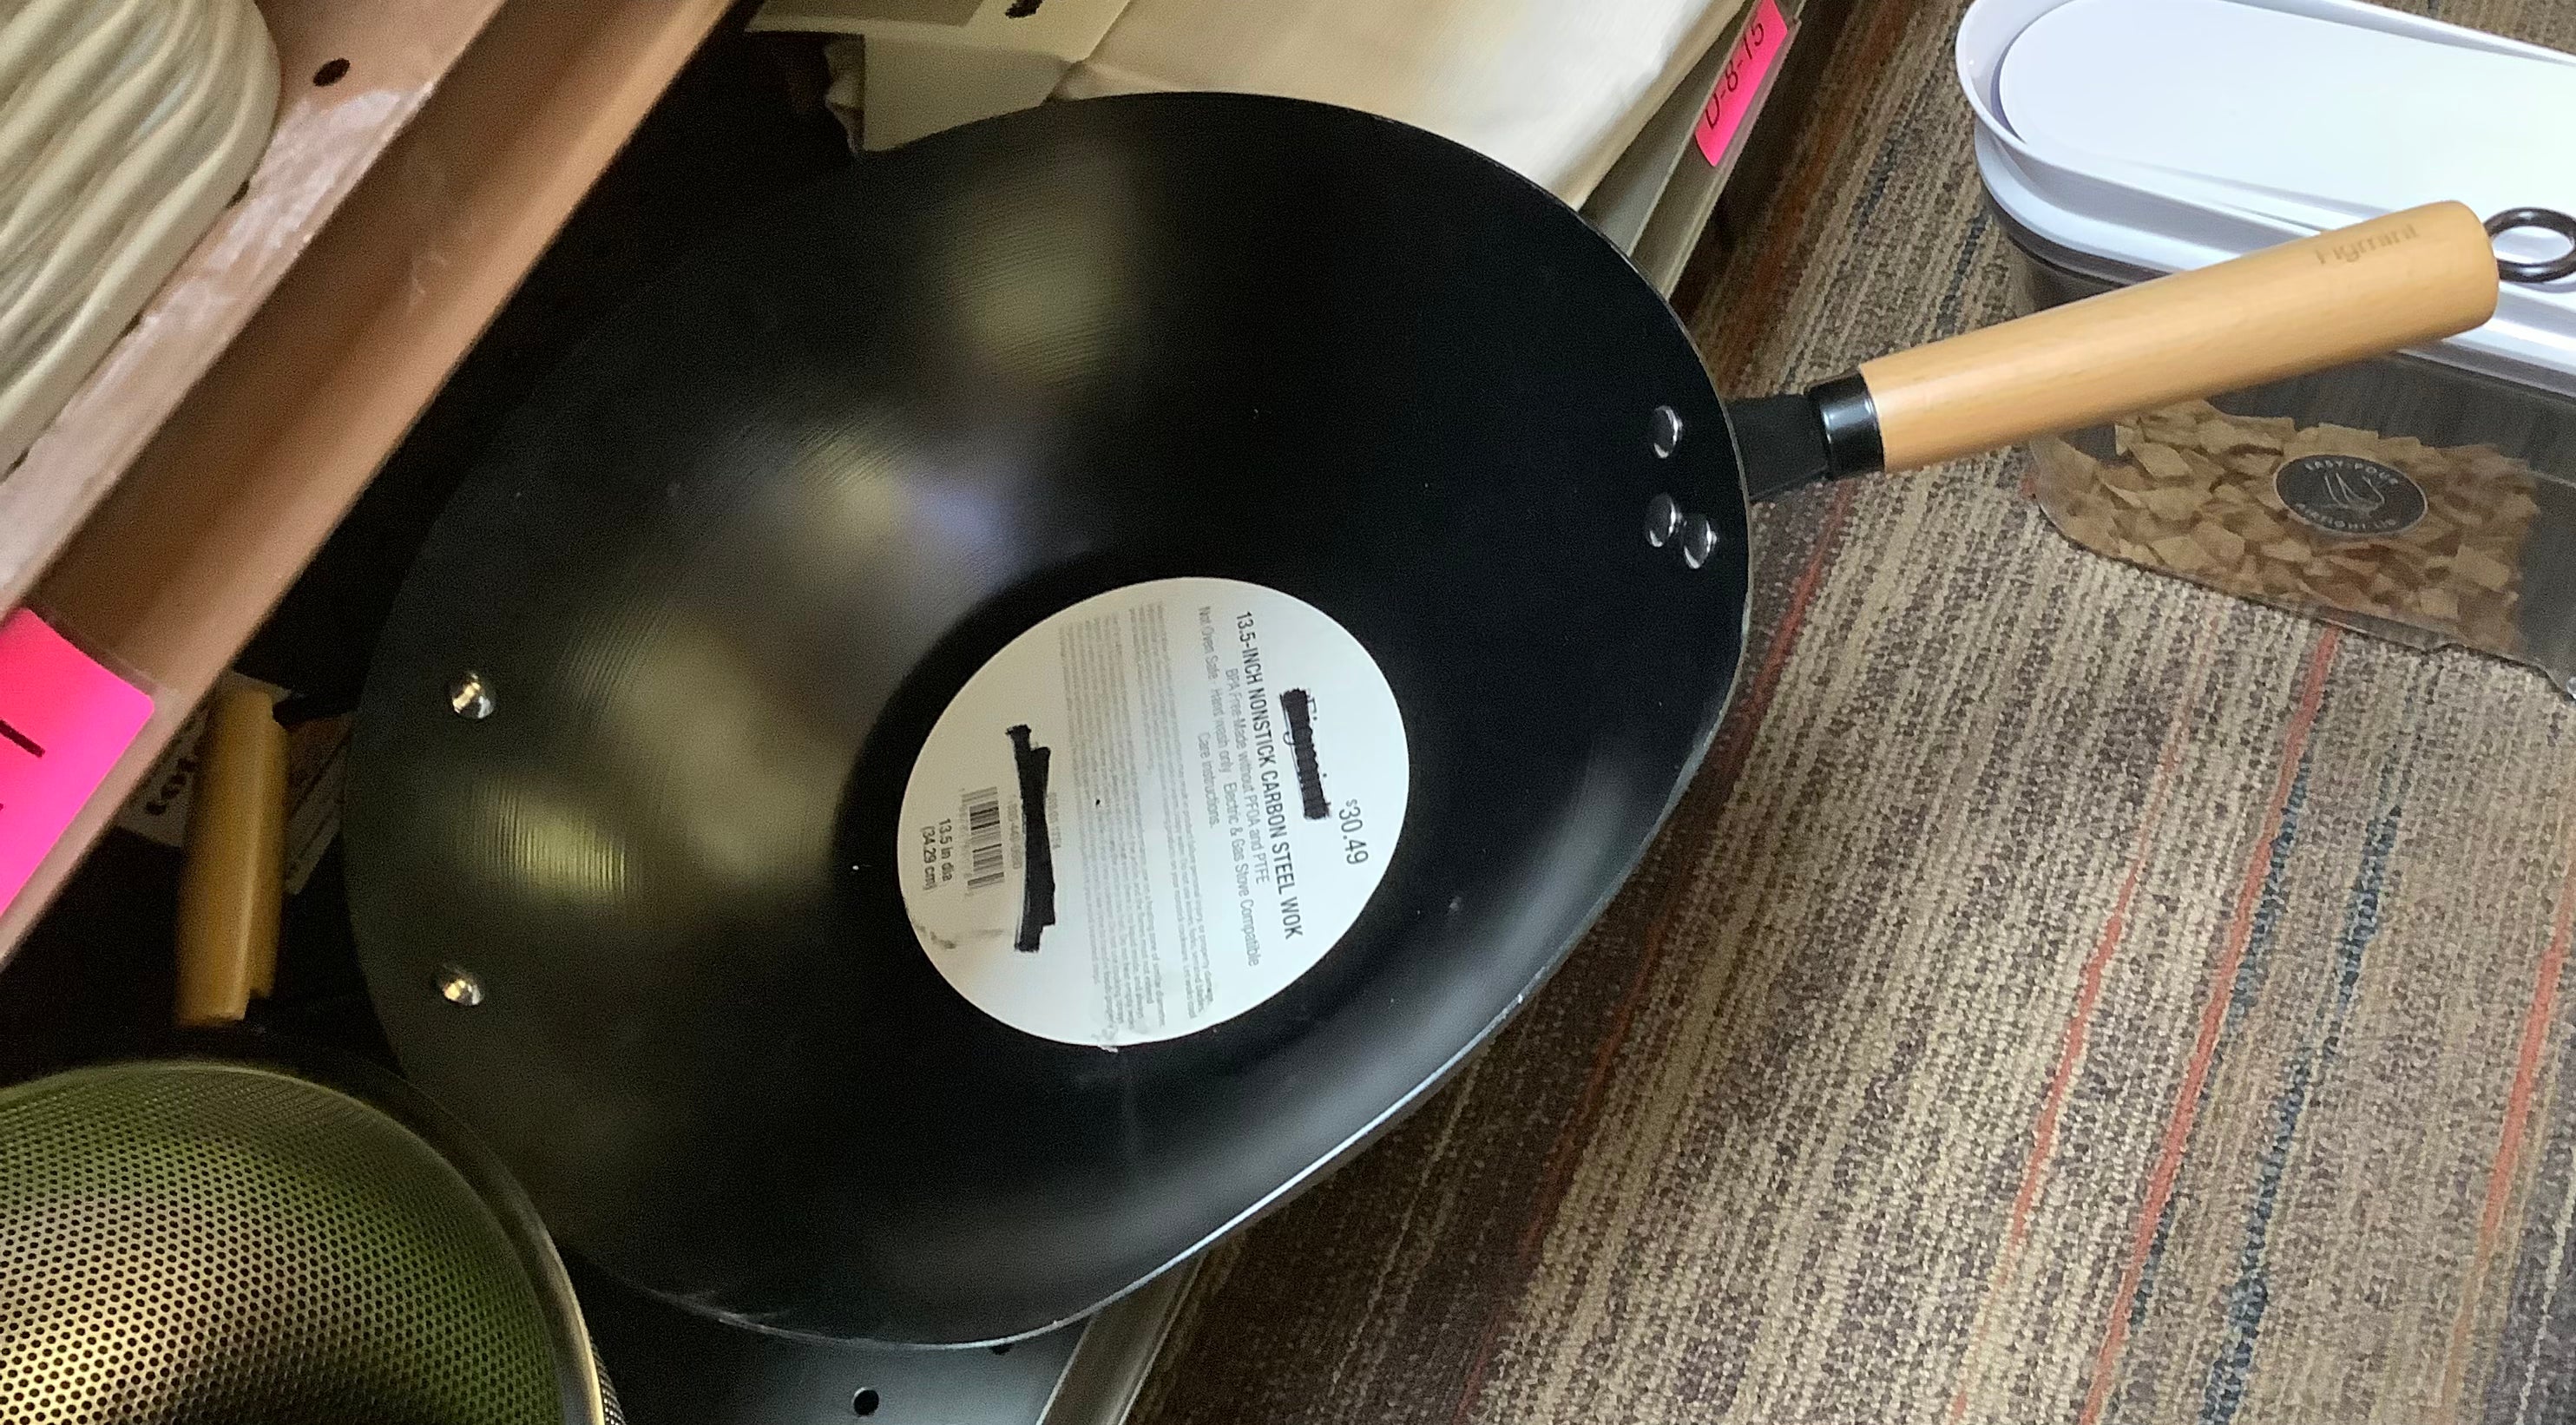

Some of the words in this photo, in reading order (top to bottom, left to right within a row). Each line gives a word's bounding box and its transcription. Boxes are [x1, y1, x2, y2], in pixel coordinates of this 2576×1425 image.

[1236, 611, 1264, 686] 13.5-INCH
[1205, 654, 1219, 680] Safe
[1226, 667, 1240, 691] BPA
[1212, 689, 1226, 717] Hand
[1214, 719, 1230, 749] wash
[1248, 687, 1277, 768] NONSTICK
[1197, 732, 1212, 758] Care
[1219, 750, 1233, 773] only
[1238, 752, 1255, 792] without
[1224, 782, 1239, 824] Electric
[1244, 792, 1261, 825] PFOA
[1261, 768, 1287, 839] CARBON
[938, 818, 953, 844] 13.5
[1230, 827, 1244, 837] &
[1249, 828, 1264, 852] and
[1339, 798, 1369, 865] $30.49
[1232, 839, 1245, 862] Gas
[922, 866, 937, 890] cm)
[941, 862, 955, 882] dia
[1236, 864, 1250, 896] Stove
[1254, 852, 1270, 885] PTFE
[1272, 841, 1296, 895] STEEL
[1240, 898, 1261, 967] Compatible
[1280, 896, 1303, 940] WOK
